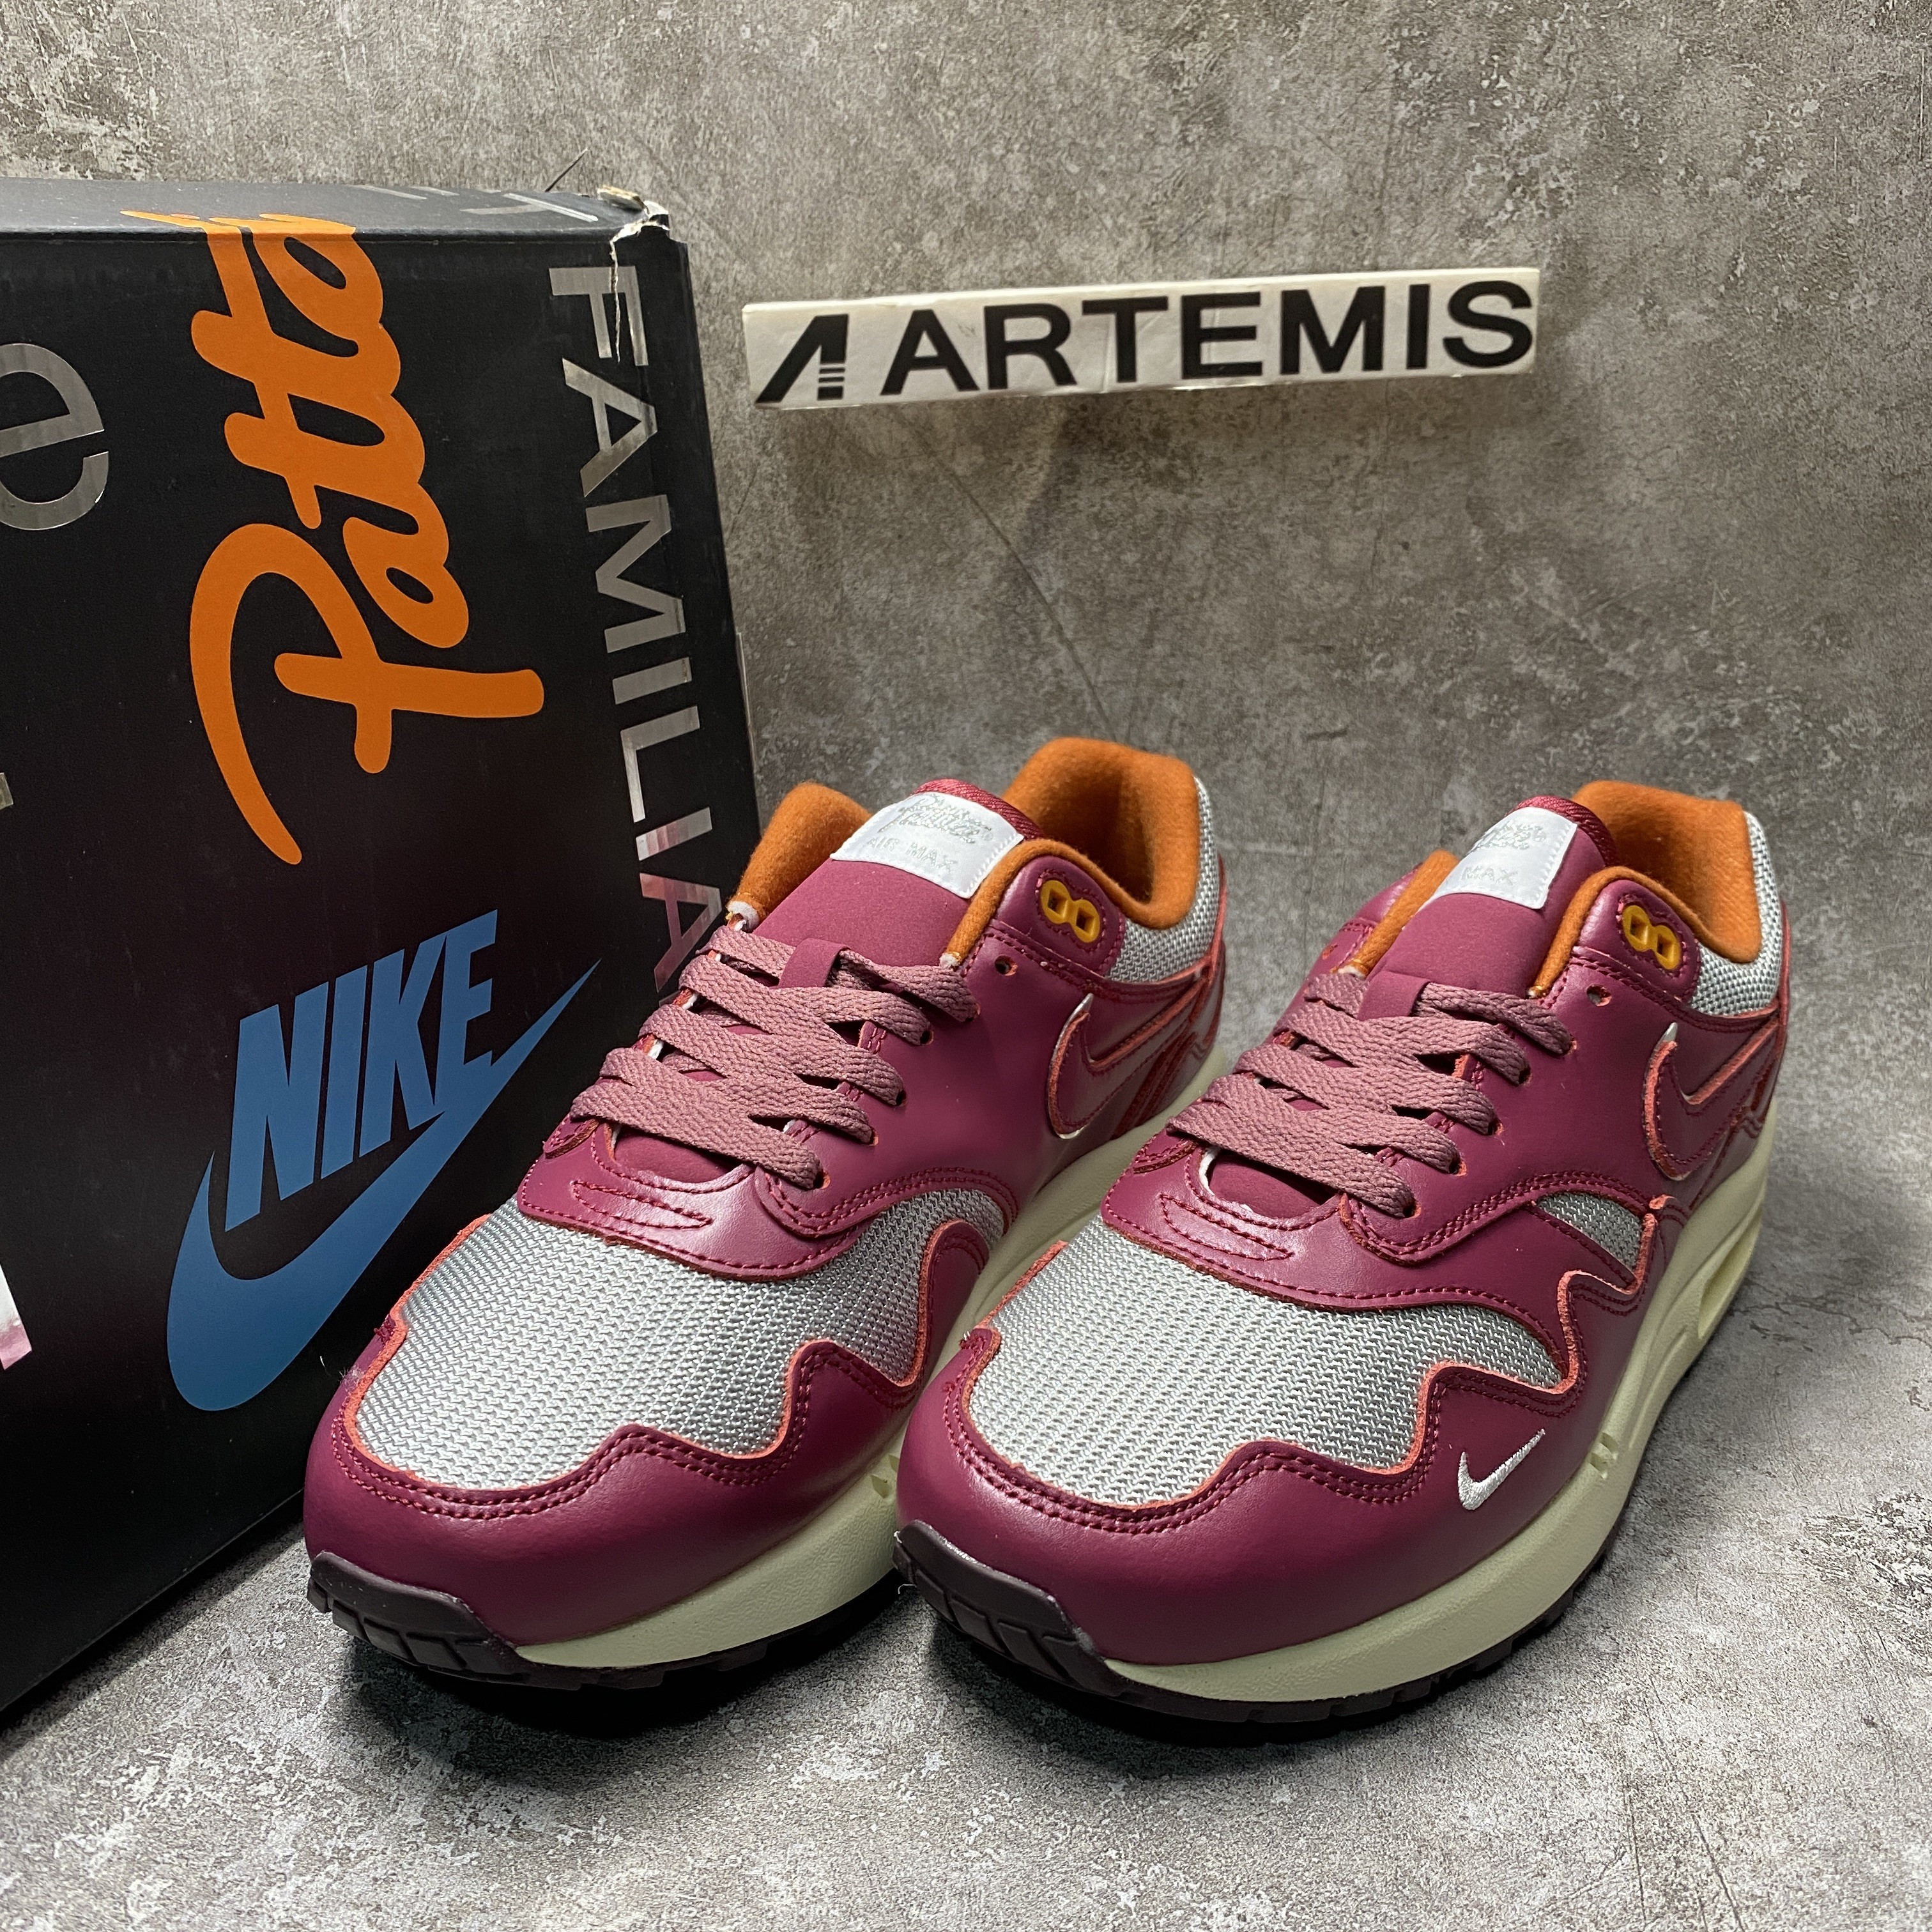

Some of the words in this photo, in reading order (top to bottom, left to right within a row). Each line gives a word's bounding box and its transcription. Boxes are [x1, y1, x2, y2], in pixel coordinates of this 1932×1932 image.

[880, 279, 1534, 396] ARTEMIS
[120, 211, 545, 865] Patta
[549, 265, 722, 1007] FAMILIA
[907, 841, 958, 873] MAX
[1460, 866, 1519, 886] MAX
[225, 908, 498, 1233] NIKE
